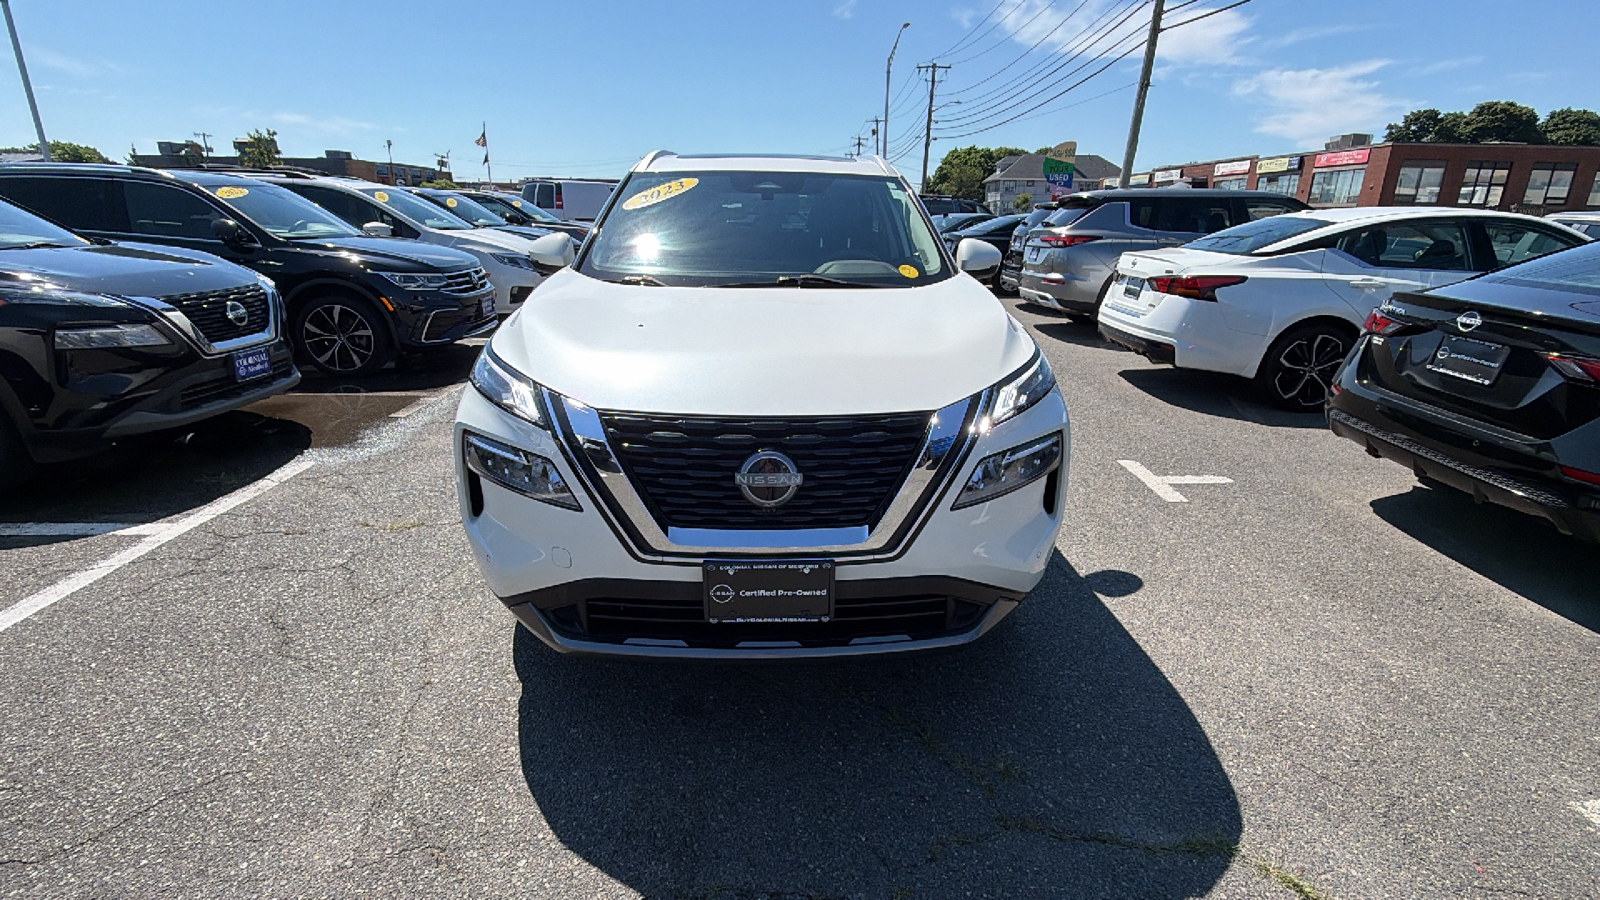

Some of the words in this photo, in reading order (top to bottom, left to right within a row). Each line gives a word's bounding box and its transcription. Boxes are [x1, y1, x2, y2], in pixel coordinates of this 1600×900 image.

[1049, 165, 1069, 173] YOUR
[641, 181, 685, 204] 2023
[236, 353, 268, 367] COLONIAL
[736, 474, 801, 485] NISSAN
[739, 589, 776, 597] Certified
[778, 589, 827, 597] Pre-Owned
